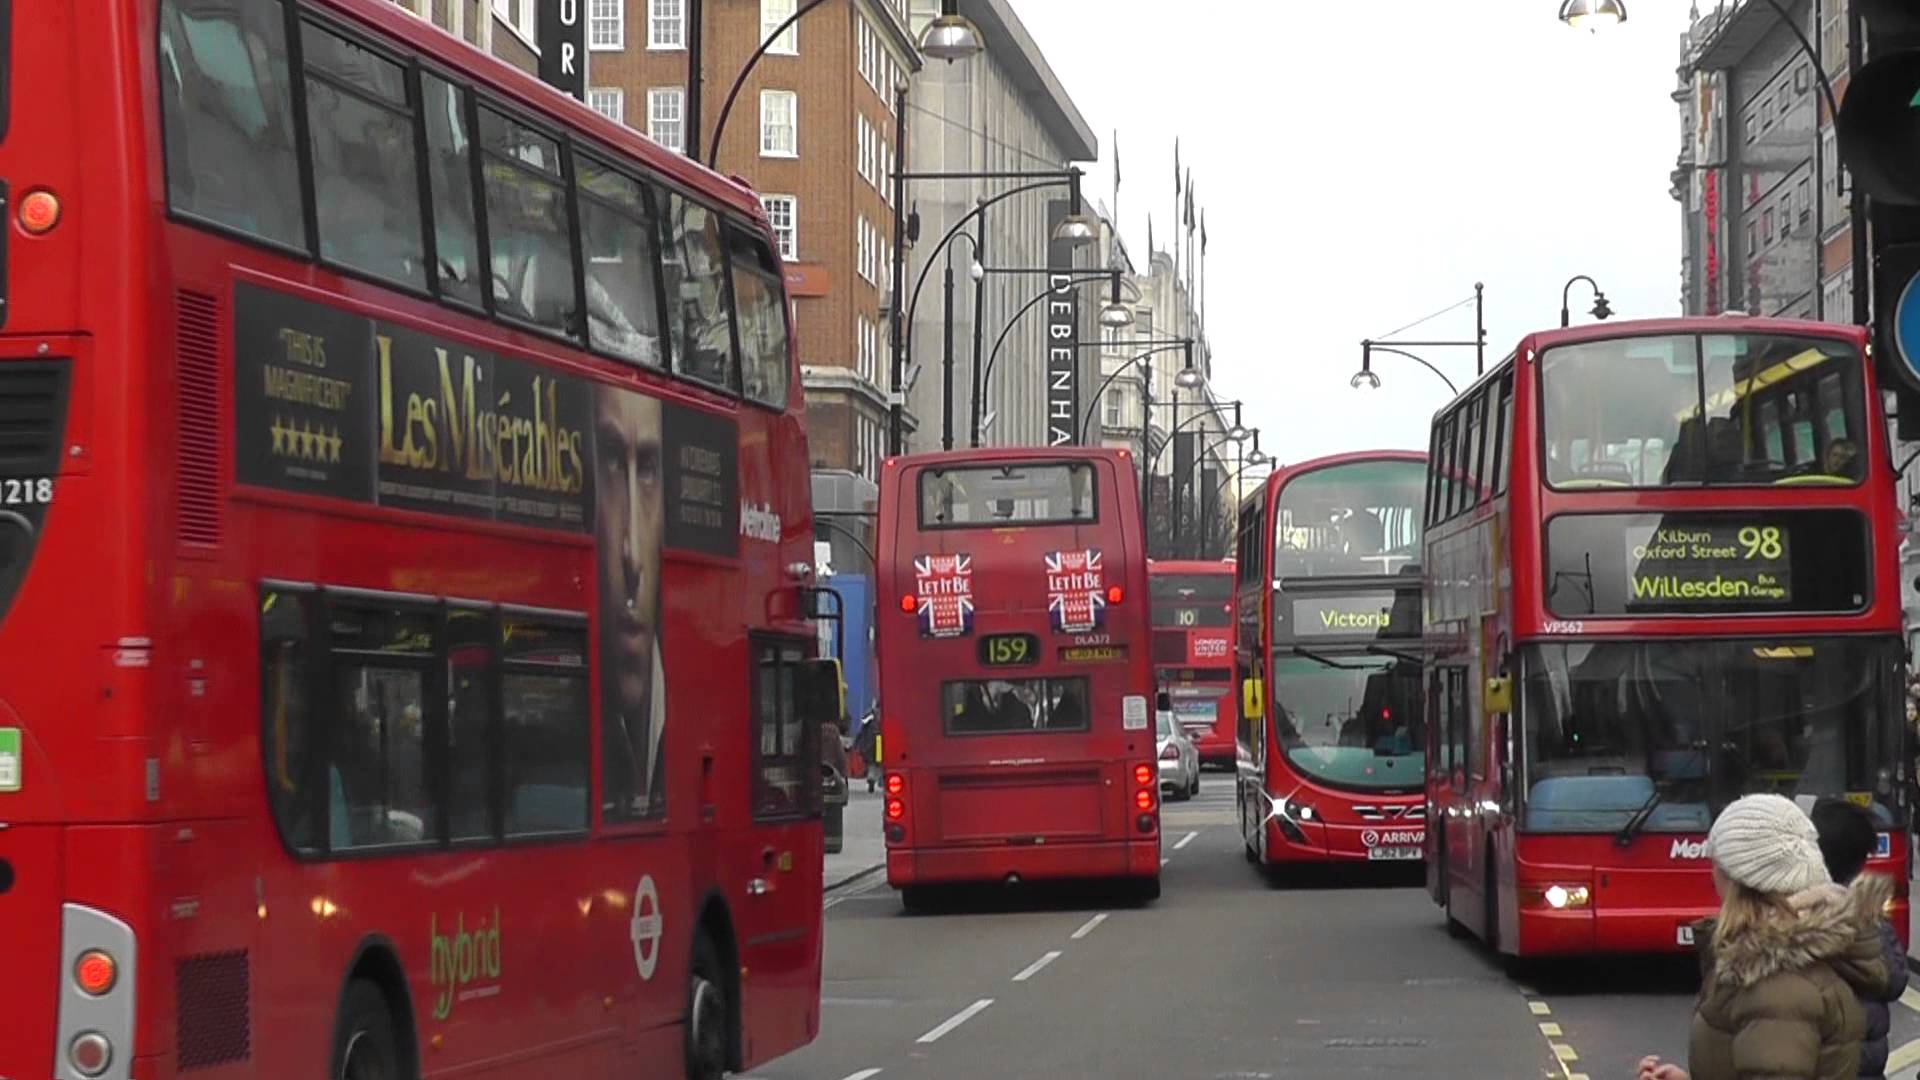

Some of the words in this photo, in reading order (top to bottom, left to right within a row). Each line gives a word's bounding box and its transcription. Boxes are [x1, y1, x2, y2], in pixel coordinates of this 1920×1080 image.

[1051, 274, 1072, 446] DEBENHA
[376, 335, 437, 469] Les
[435, 347, 583, 496] Misérables
[1658, 529, 1711, 543] Kilburn
[1738, 526, 1782, 559] 98
[1633, 545, 1686, 559] Oxford
[1692, 544, 1737, 558] Street
[918, 579, 938, 596] LET
[940, 577, 952, 594] IT
[953, 576, 970, 593] BE
[1048, 575, 1069, 591] LET
[1071, 573, 1082, 590] IT
[1084, 571, 1101, 588] BE
[1631, 575, 1749, 598] Willesden
[1751, 586, 1785, 598] Garage
[1758, 574, 1776, 584] Bus
[1180, 610, 1194, 625] 10
[1320, 609, 1390, 627] Victoria
[989, 638, 1027, 662] 159
[431, 903, 501, 1019] hybrid
